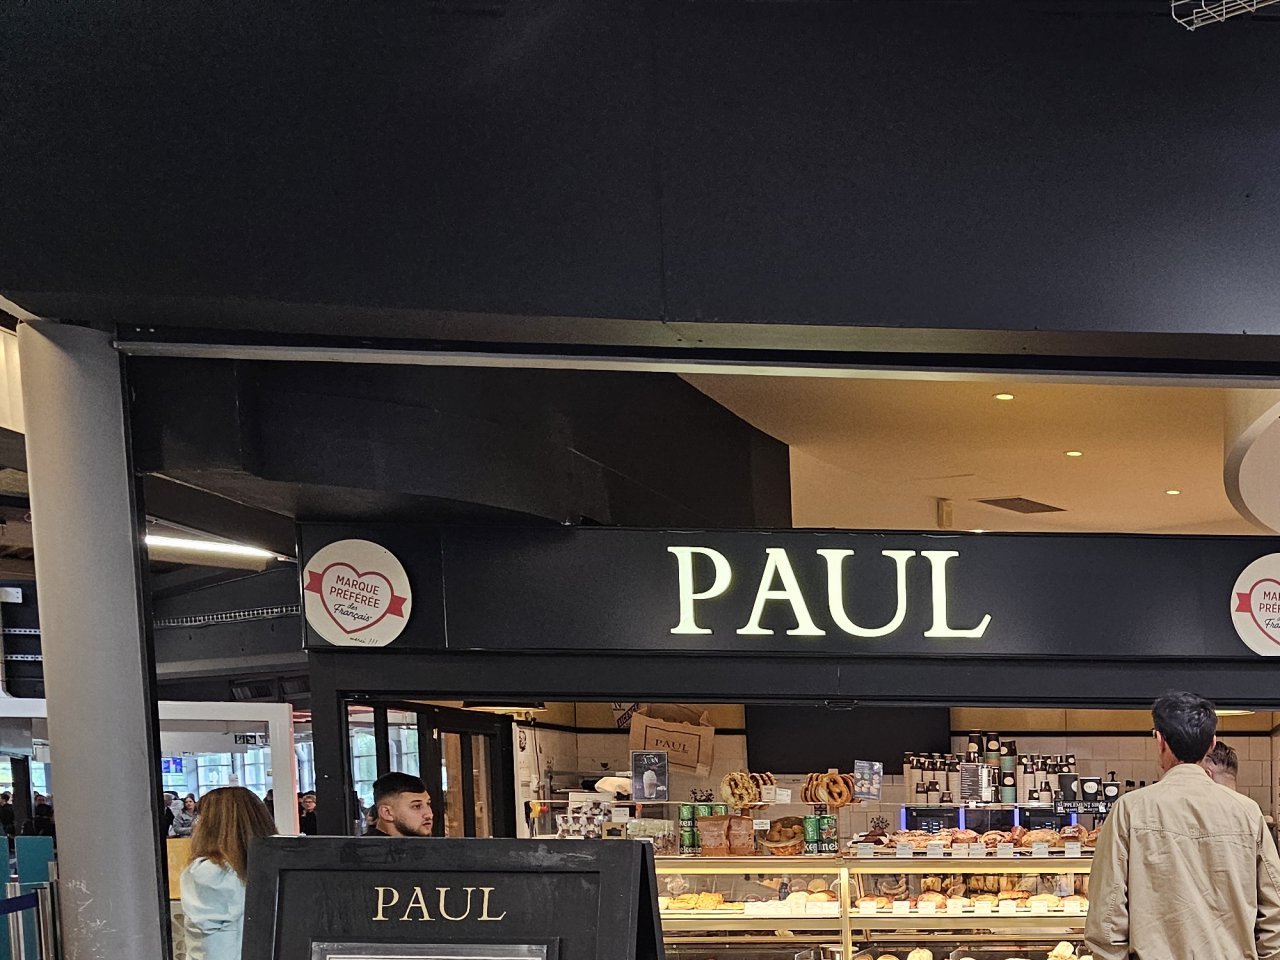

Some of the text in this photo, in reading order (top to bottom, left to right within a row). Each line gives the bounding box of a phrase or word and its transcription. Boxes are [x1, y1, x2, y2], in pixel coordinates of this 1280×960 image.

[335, 574, 380, 596] MARQUE
[667, 546, 992, 638] PAUL
[329, 586, 381, 609] PRÉFÉRÉE
[347, 602, 358, 611] des
[333, 603, 371, 622] Français
[655, 738, 689, 752] PAUL
[372, 886, 507, 921] PAUL
